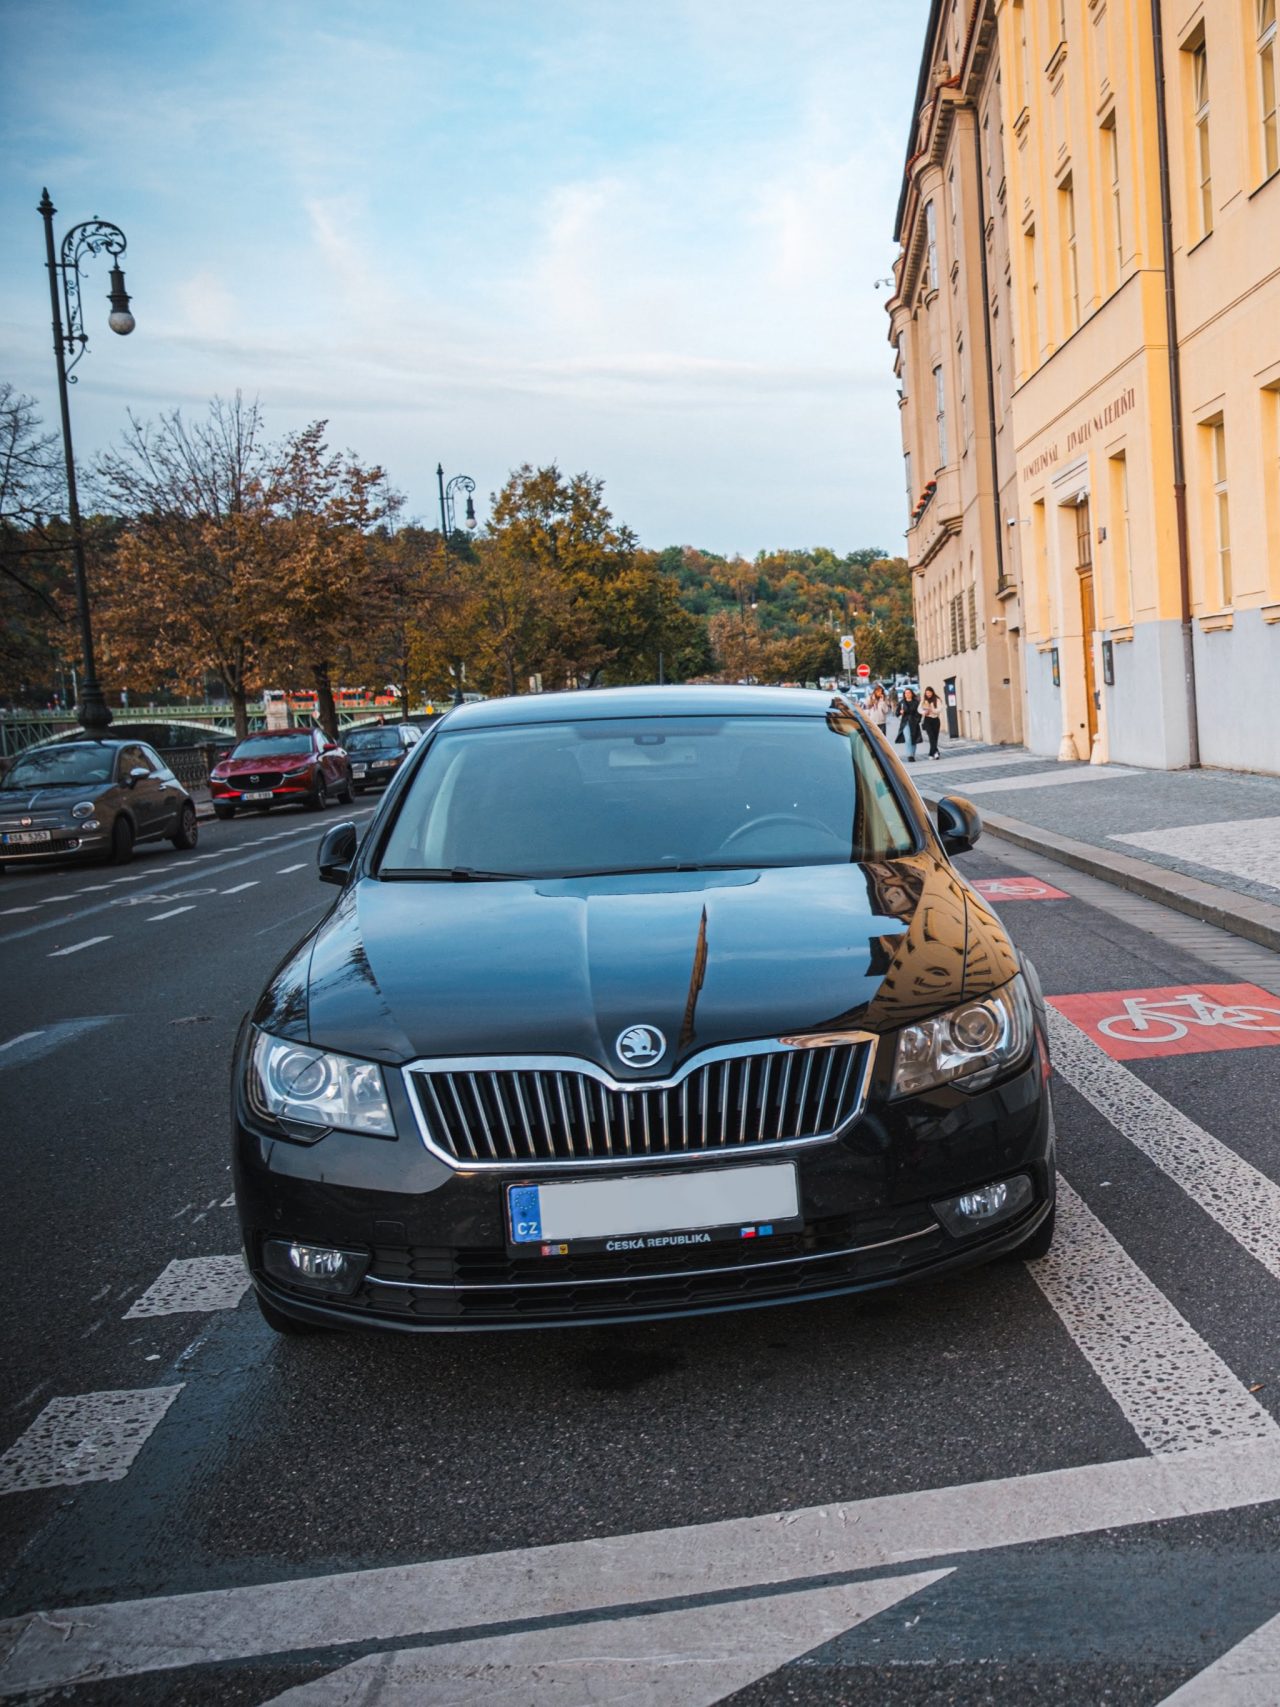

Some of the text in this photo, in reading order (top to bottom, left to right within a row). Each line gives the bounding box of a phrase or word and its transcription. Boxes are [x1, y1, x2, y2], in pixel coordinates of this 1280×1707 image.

[517, 1222, 538, 1235] CZ
[606, 1233, 711, 1251] ČESKÁ REPUBLIKA
